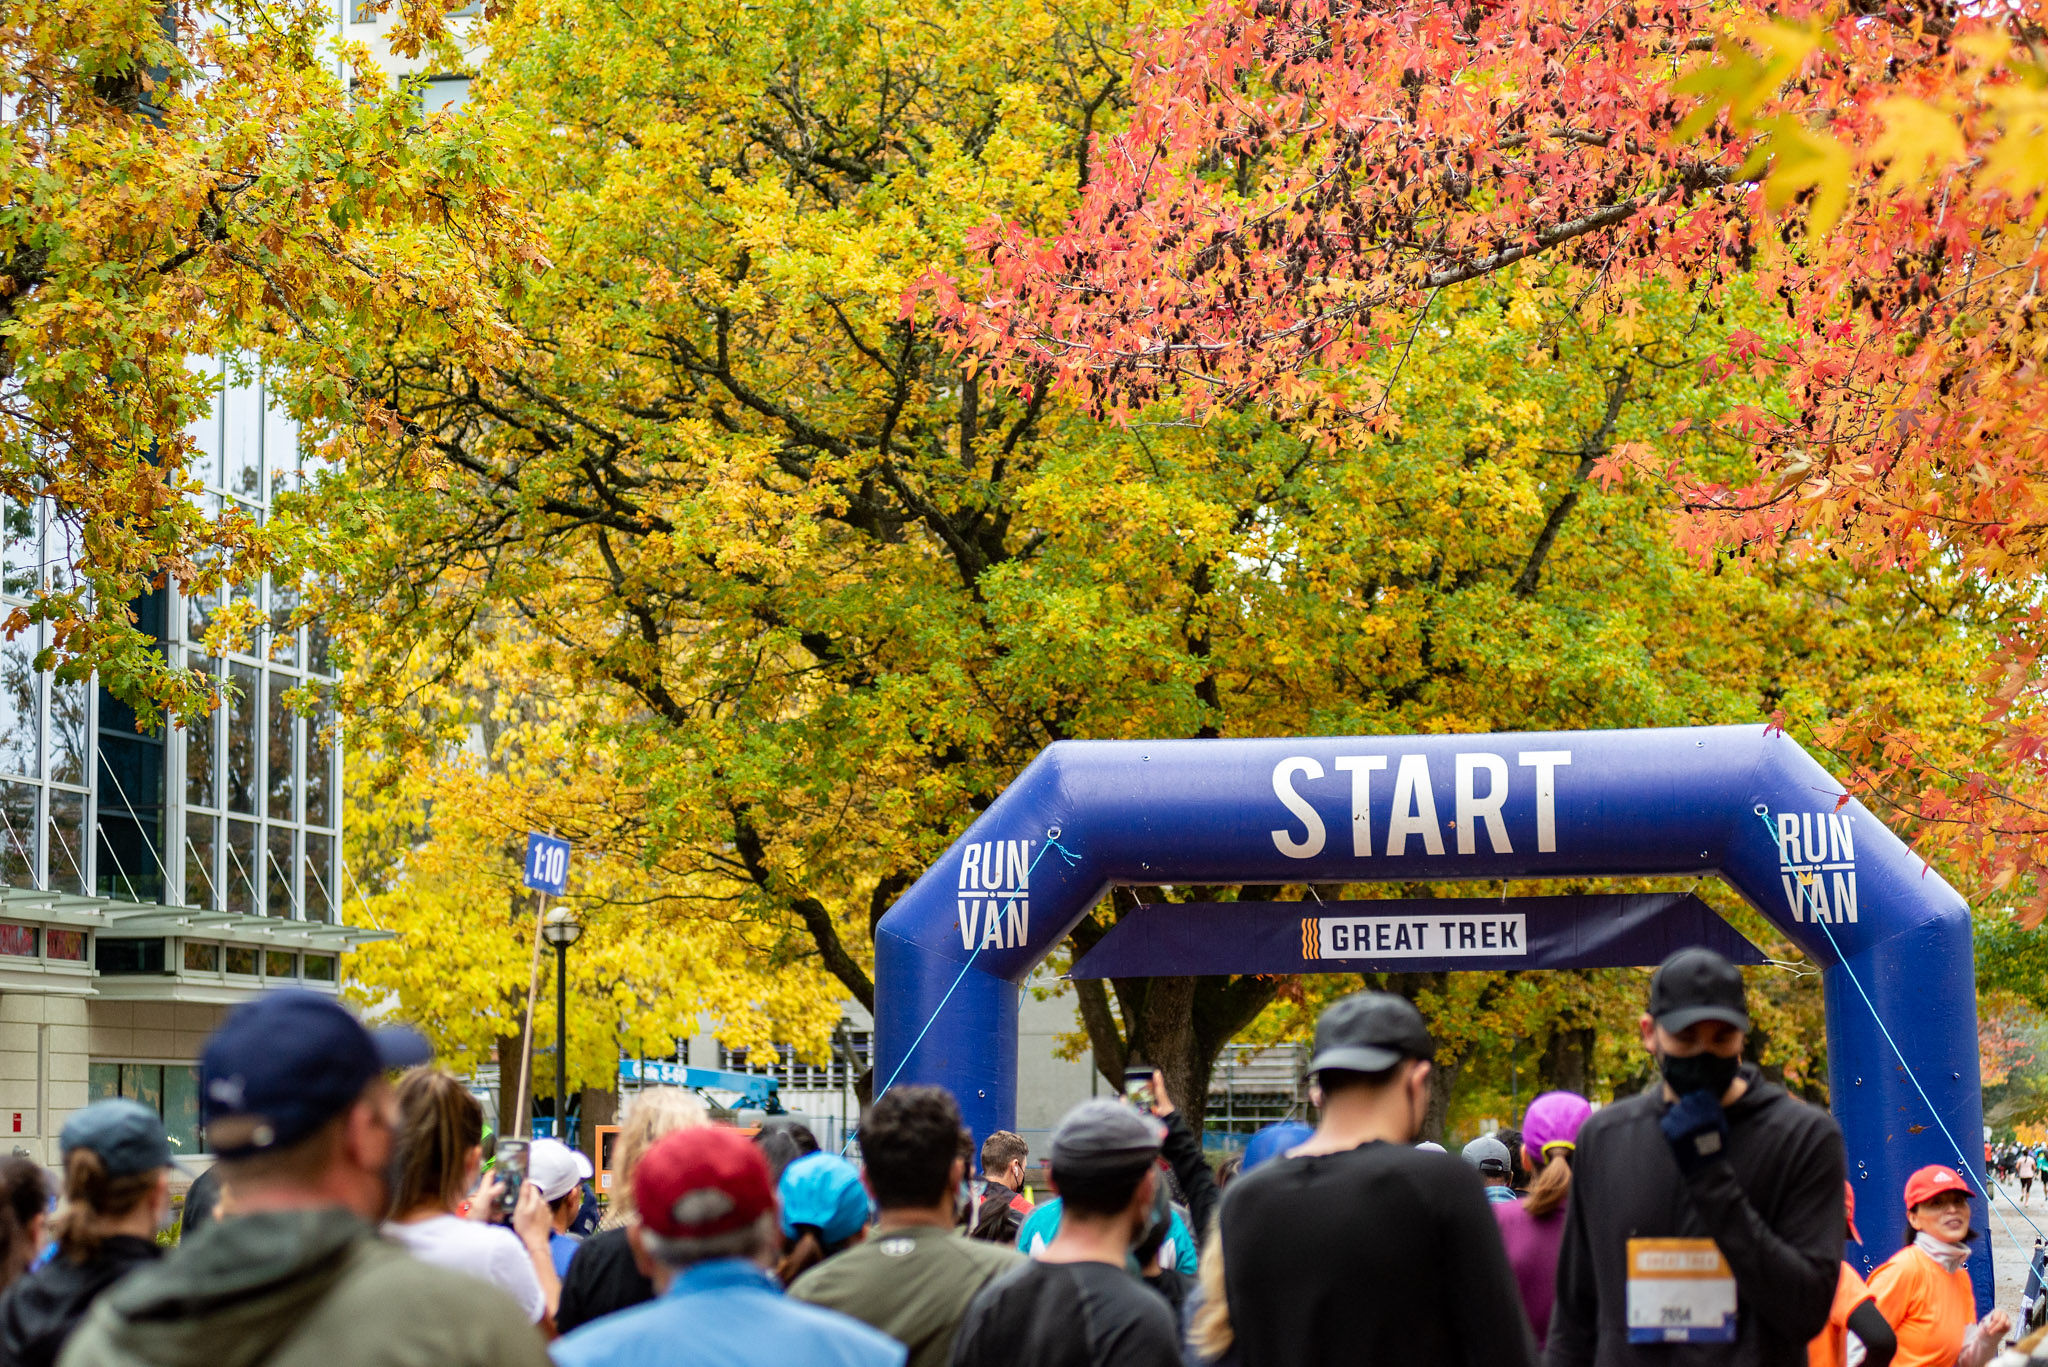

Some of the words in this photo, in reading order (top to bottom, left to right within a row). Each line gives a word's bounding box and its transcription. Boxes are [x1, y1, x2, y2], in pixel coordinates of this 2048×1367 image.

[1271, 750, 1572, 859] START
[1777, 812, 1855, 863] RUN
[533, 842, 565, 886] 1:10
[958, 840, 1029, 890] RUN
[1781, 872, 1858, 923] VAN
[958, 900, 1029, 950] VAN
[1332, 922, 1429, 951] GREAT
[1439, 921, 1518, 950] TREK
